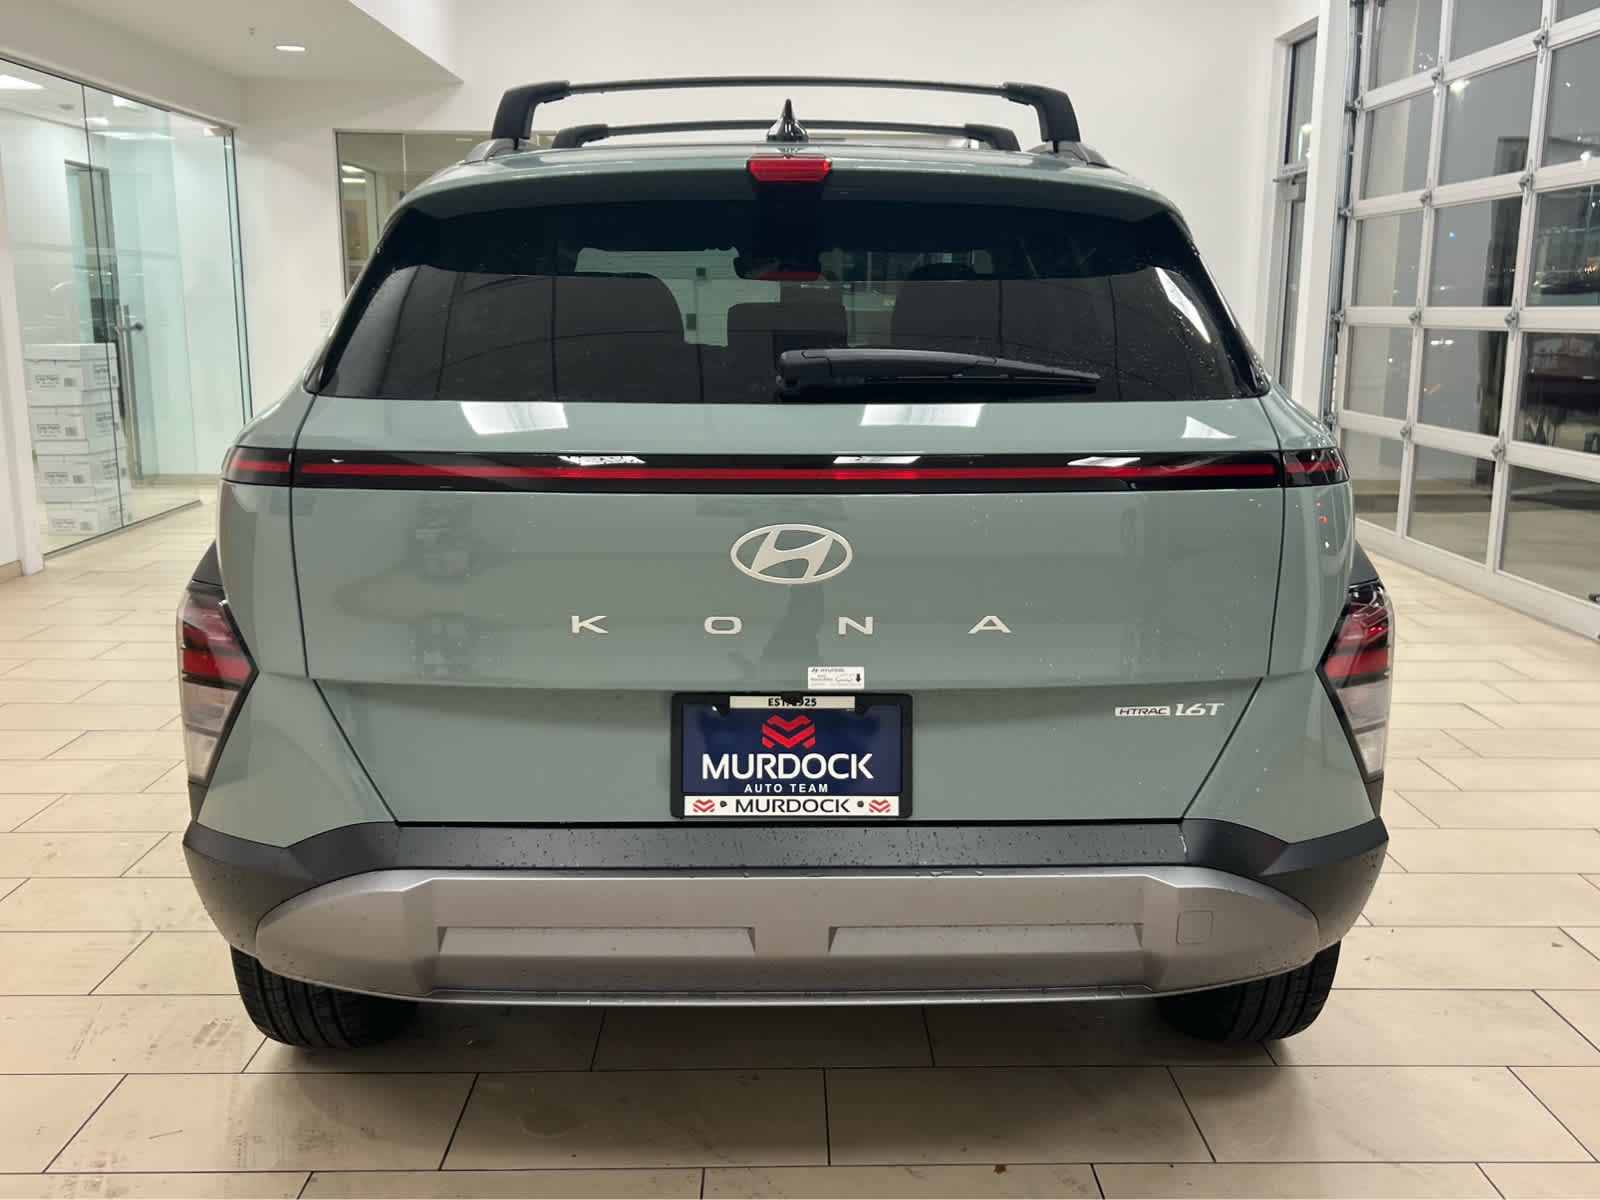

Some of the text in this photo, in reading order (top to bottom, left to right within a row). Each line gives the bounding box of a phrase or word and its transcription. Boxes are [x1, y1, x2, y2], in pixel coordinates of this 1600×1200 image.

[571, 615, 1012, 635] KONA
[1118, 707, 1168, 716] HTRAC
[702, 753, 874, 780] MURDOCK
[744, 783, 828, 793] AUTO TEAM
[735, 798, 851, 813] MURDOCK
